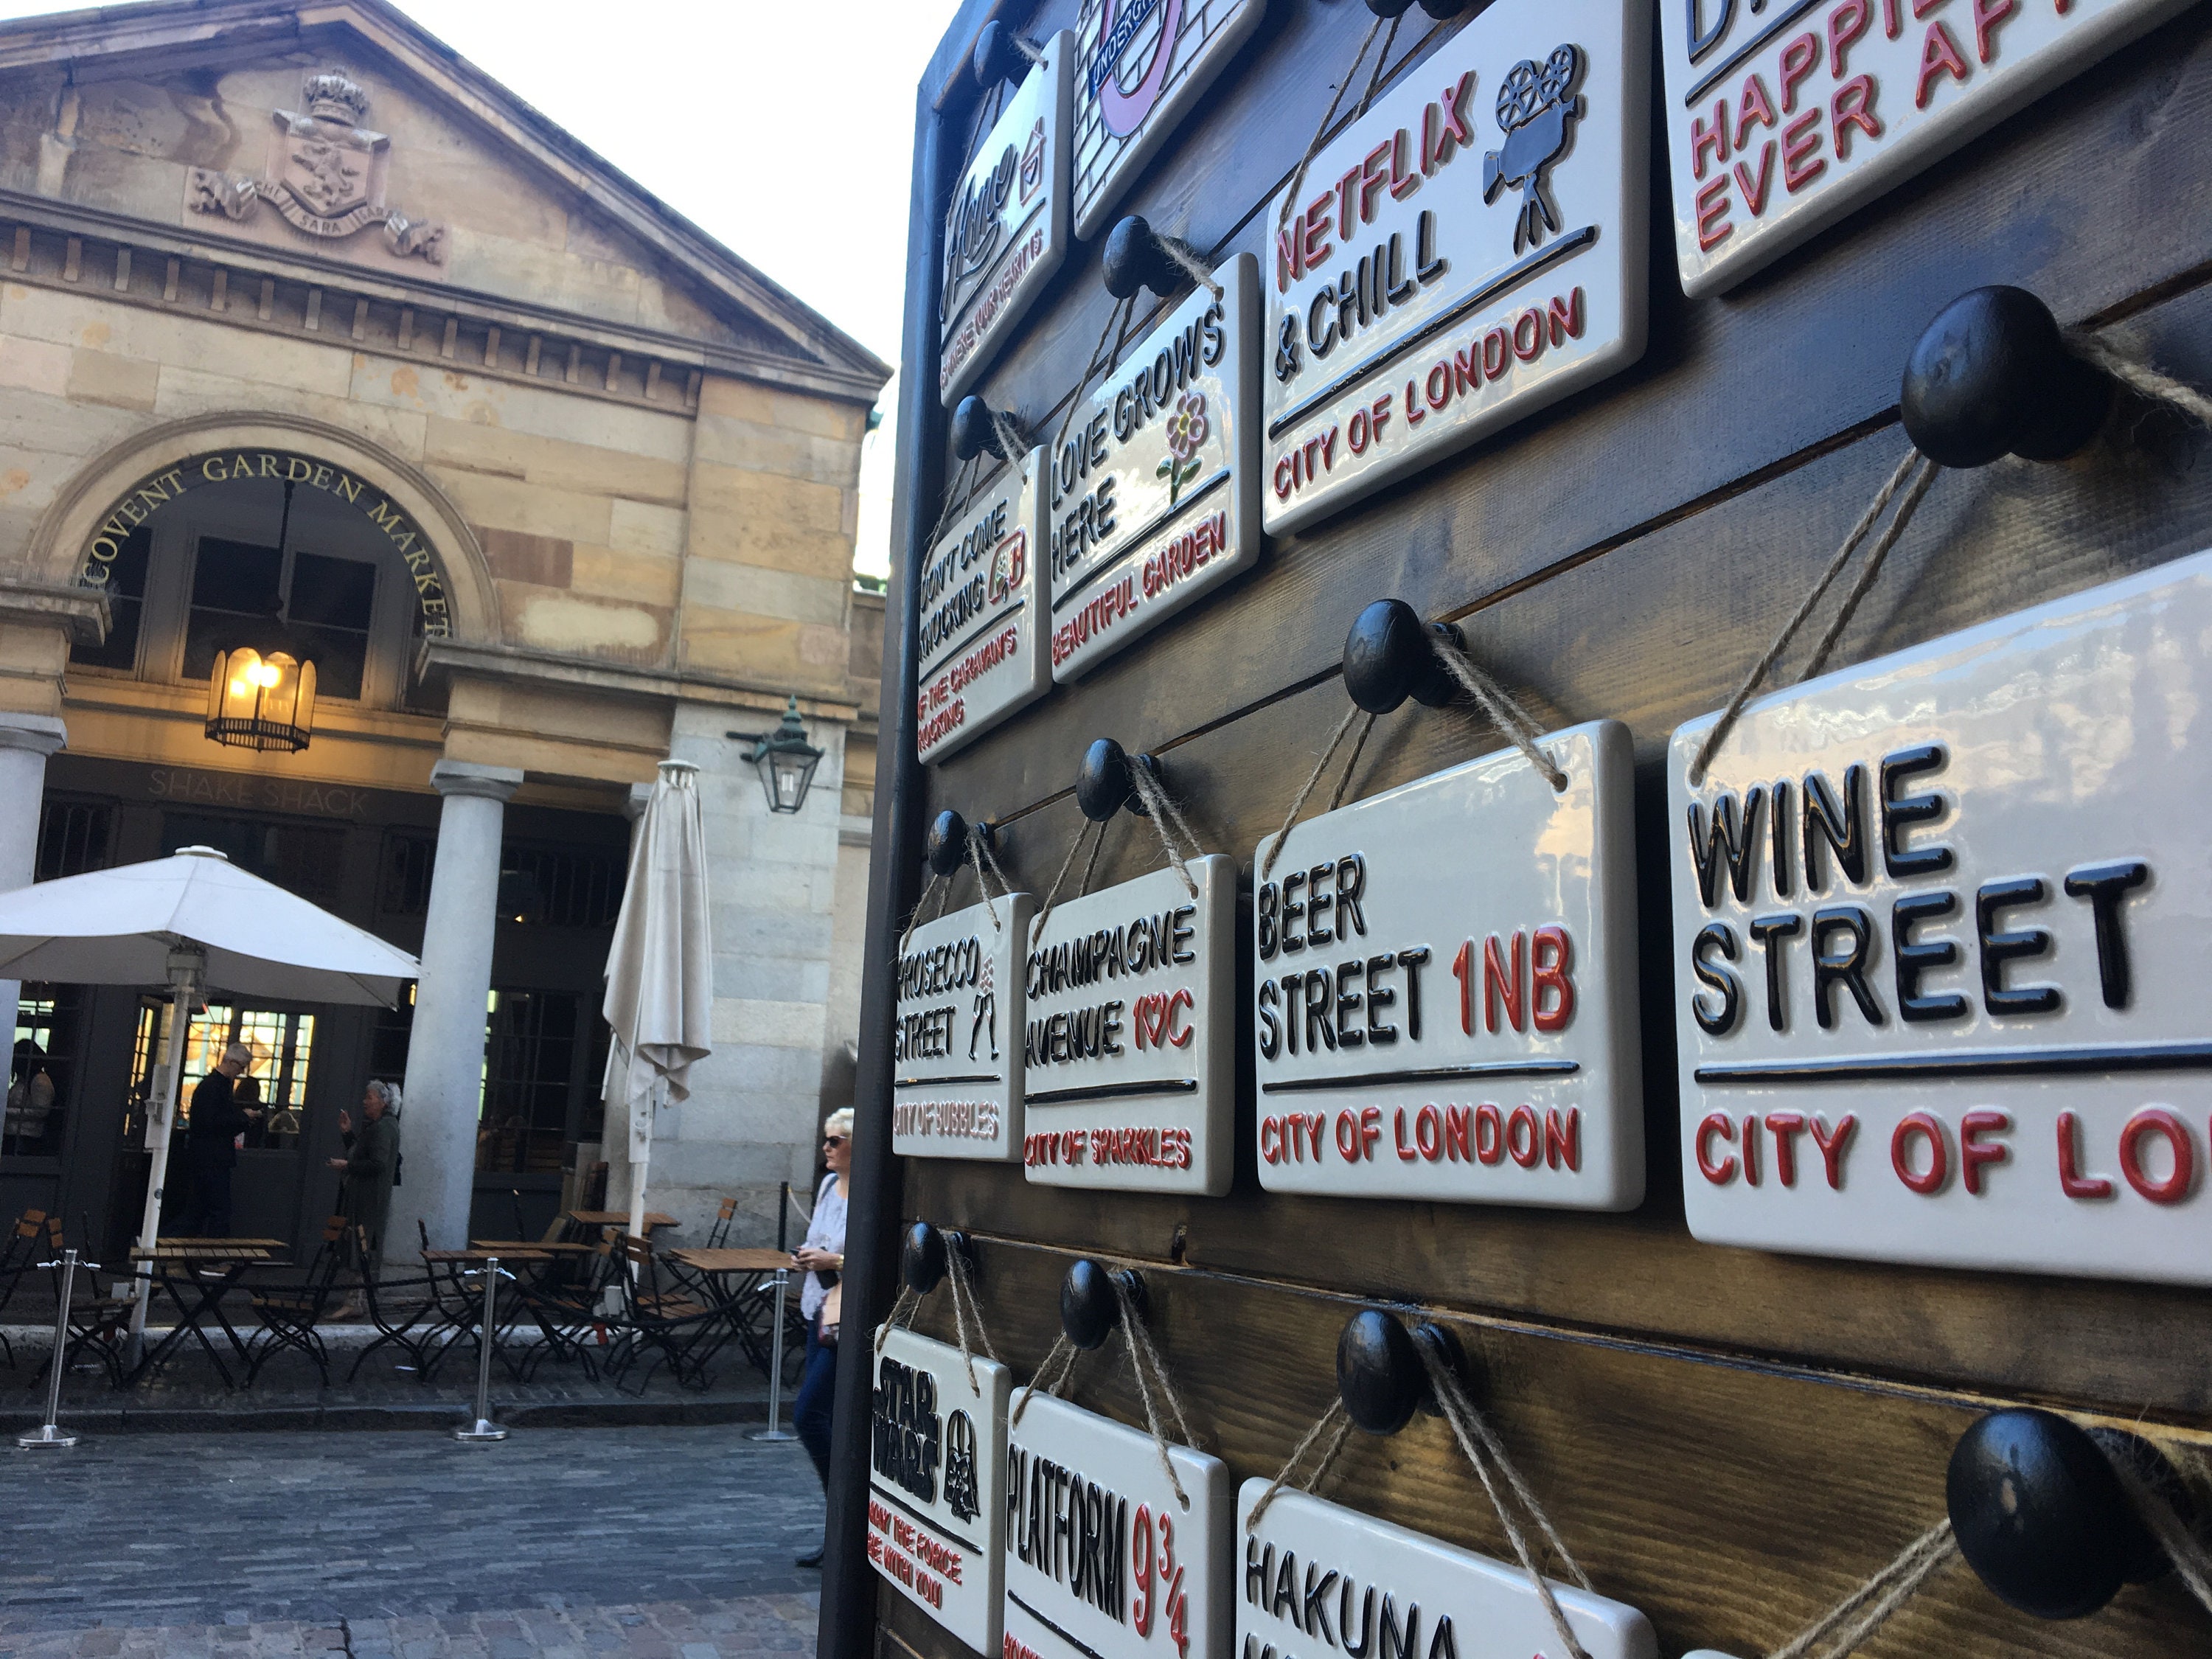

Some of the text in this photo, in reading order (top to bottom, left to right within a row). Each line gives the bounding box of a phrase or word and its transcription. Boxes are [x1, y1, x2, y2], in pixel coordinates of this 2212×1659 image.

[1276, 69, 1478, 294] NETFLIX
[1697, 74, 1880, 252] EVER
[1274, 210, 1447, 382] & CHILL
[1052, 302, 1225, 511] LOVE GROWS
[1274, 286, 1582, 499] CITY OF LONDON
[83, 453, 448, 639] COVENT GARDEN MARKET
[961, 497, 1009, 571] COME
[1052, 475, 1116, 582] HERE
[1052, 509, 1227, 667] BEAUTIFUL GARDEN
[928, 672, 950, 712] THE
[147, 769, 369, 818] SHAKE SHACK
[1687, 743, 1955, 908] WINE
[1026, 904, 1197, 1000] CHAMPAGNE
[1259, 852, 1366, 961] BEER
[1692, 860, 2149, 1035] STREET
[897, 934, 981, 1003] PROSECCO
[1259, 925, 1574, 1060] STREET 1NB
[895, 1005, 958, 1062] STREET
[1024, 999, 1124, 1068] AVENUE
[893, 1100, 1000, 1141] CITY OF BUBBLES
[1023, 1127, 1192, 1170] CITY OF SPARKLES
[1261, 1103, 1581, 1172] CITY OF LONDON
[1696, 1108, 2212, 1206] CITY OF LO
[883, 1543, 914, 1588] WITH
[915, 1568, 942, 1610] YOU
[893, 1514, 916, 1554] THE
[916, 1532, 962, 1586] FORCE
[1006, 1443, 1127, 1625] PLATFORM
